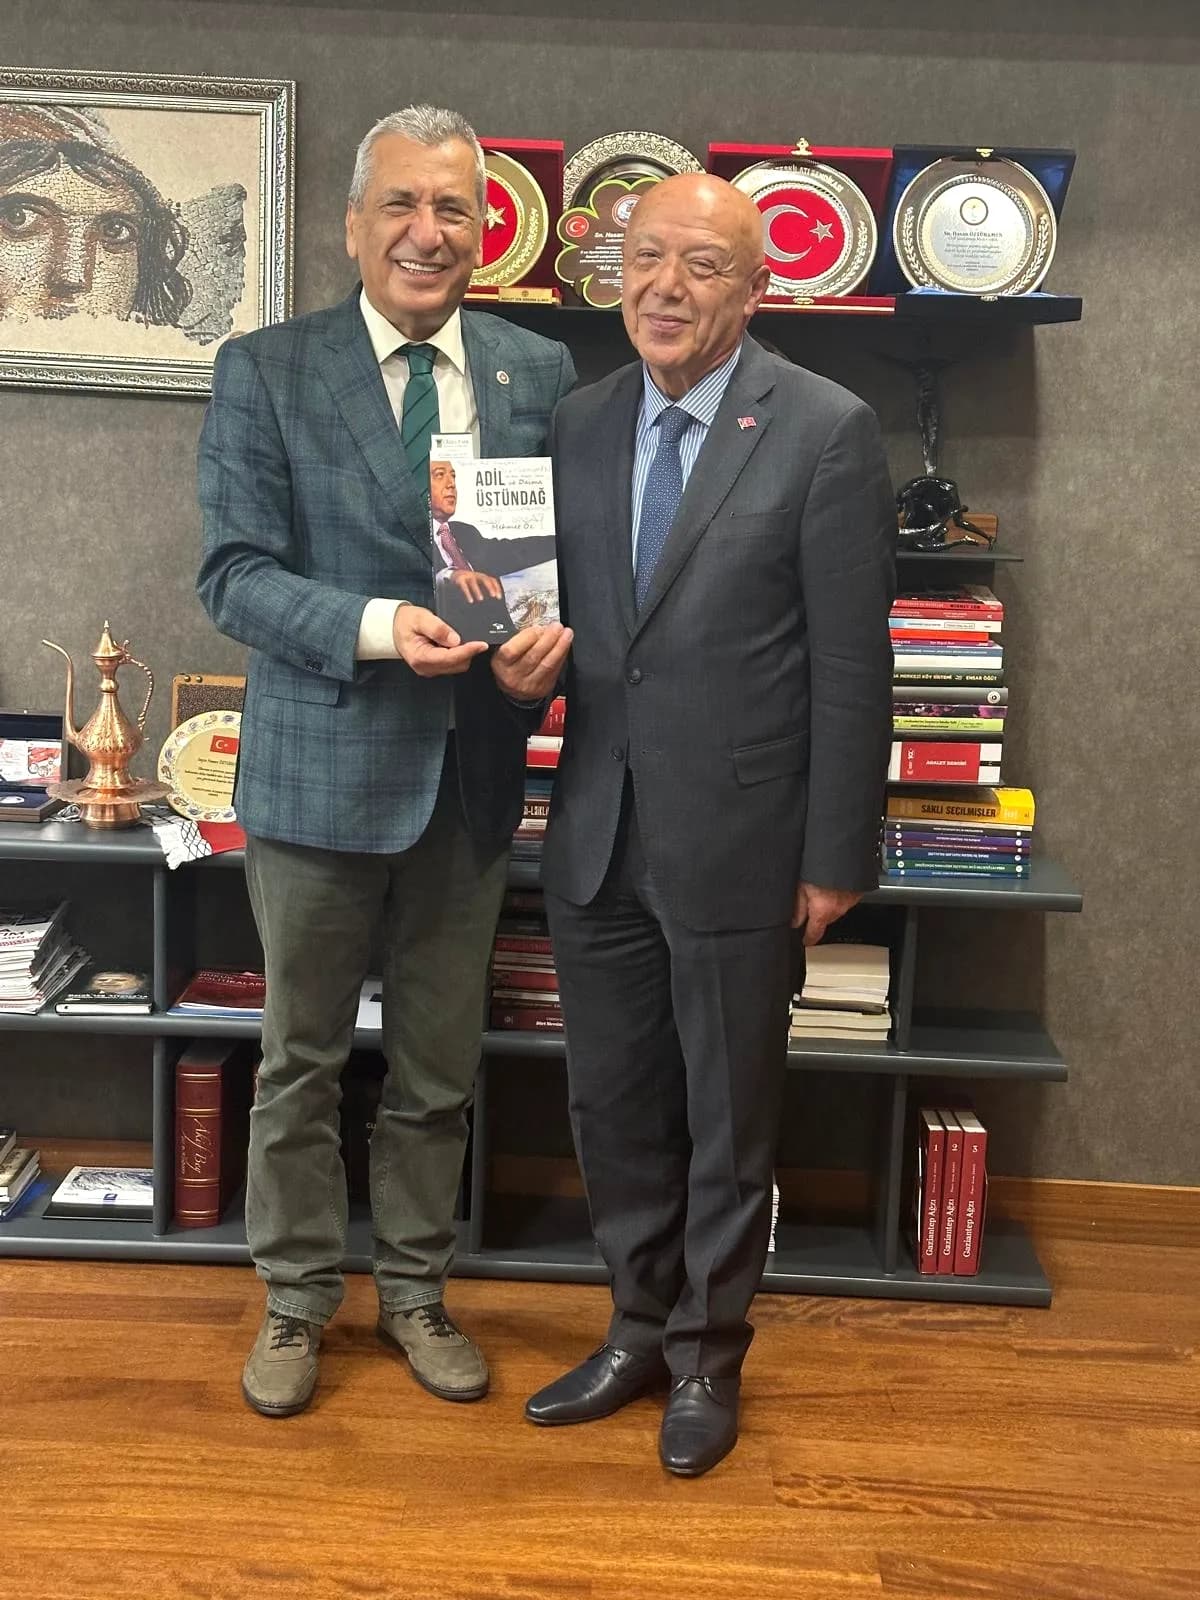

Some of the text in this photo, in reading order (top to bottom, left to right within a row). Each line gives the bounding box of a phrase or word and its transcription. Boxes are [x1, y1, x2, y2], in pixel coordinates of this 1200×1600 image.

[475, 468, 506, 487] ADİL
[476, 487, 546, 507] ÜSTÜNDAĞ
[921, 804, 944, 814] SAKLI
[933, 1144, 938, 1152] 1
[951, 1143, 958, 1151] 2
[972, 1144, 978, 1153] 3
[926, 1217, 937, 1256] Gaziantep
[943, 1217, 954, 1256] Gaziantep
[963, 1218, 974, 1258] Gaziantep
